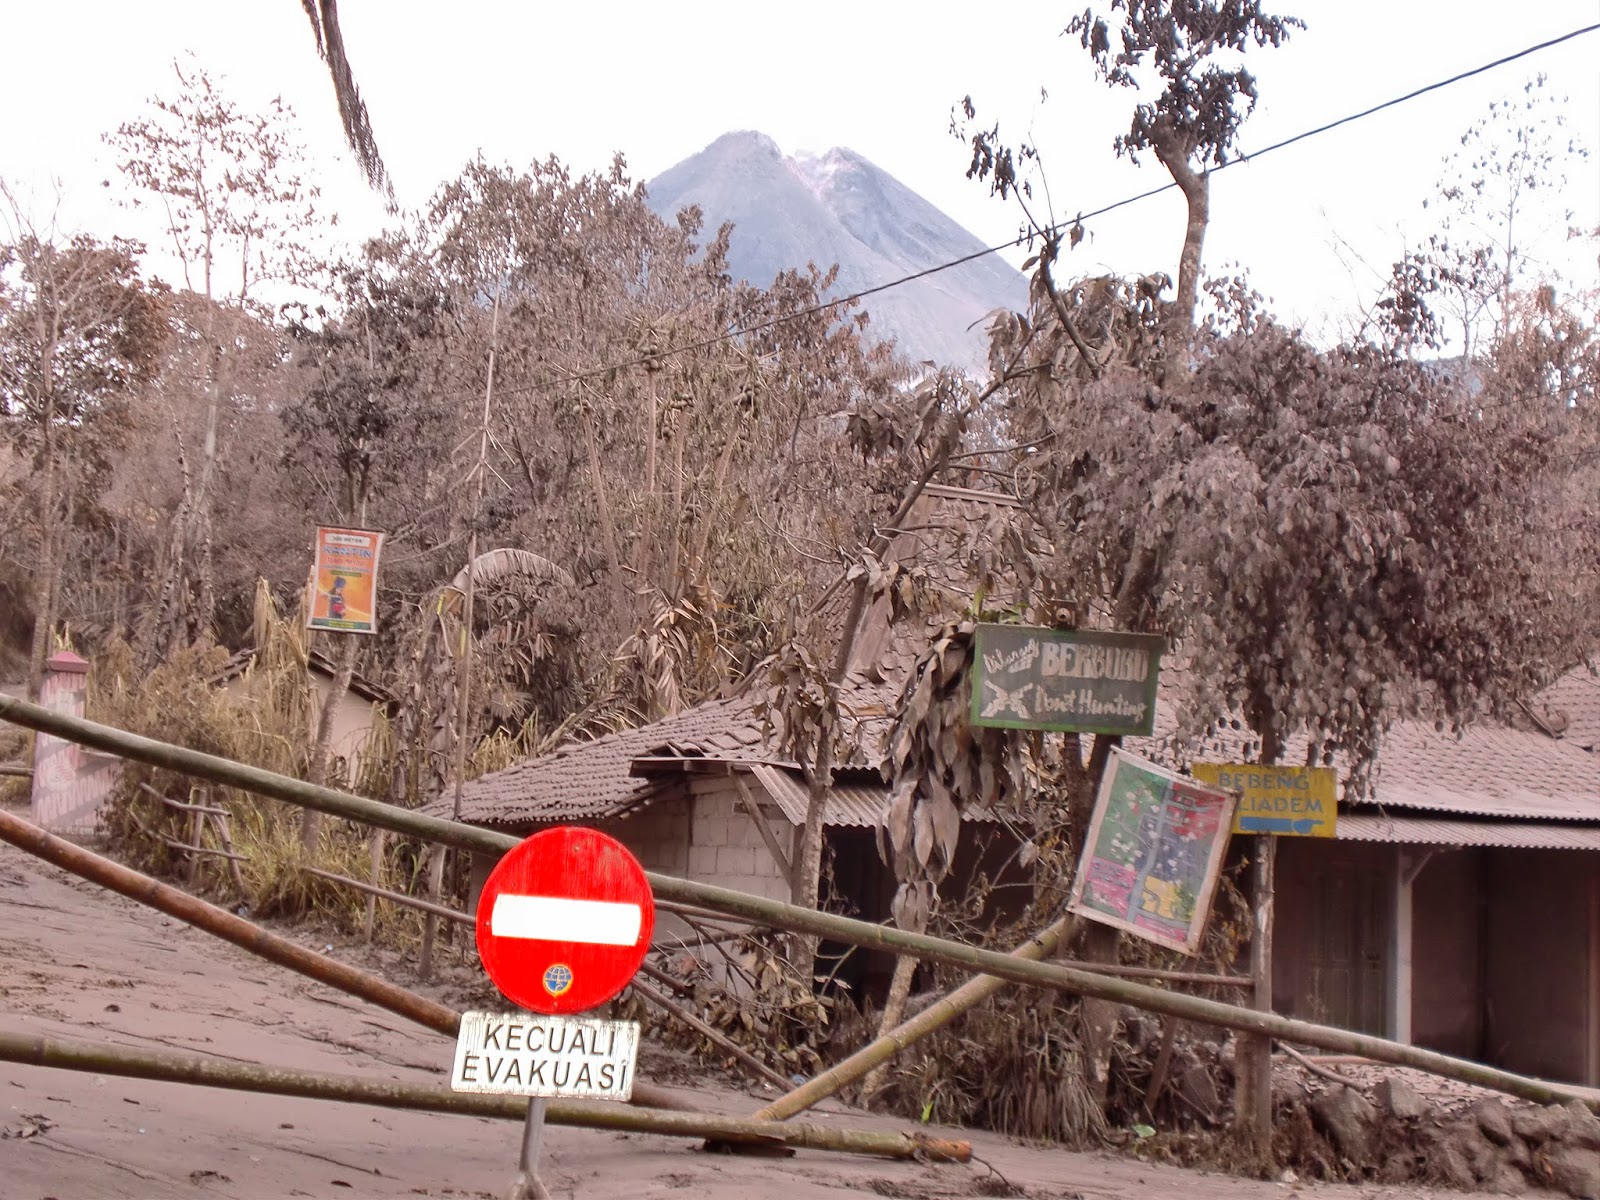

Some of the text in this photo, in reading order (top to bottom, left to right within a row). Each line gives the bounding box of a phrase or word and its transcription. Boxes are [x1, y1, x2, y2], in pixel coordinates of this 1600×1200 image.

[323, 545, 372, 558] KANTIN
[1219, 772, 1310, 791] BEBENG
[1237, 796, 1324, 814] LIADEM
[483, 1023, 615, 1057] KECUALI
[461, 1054, 628, 1092] EVAKUASI
